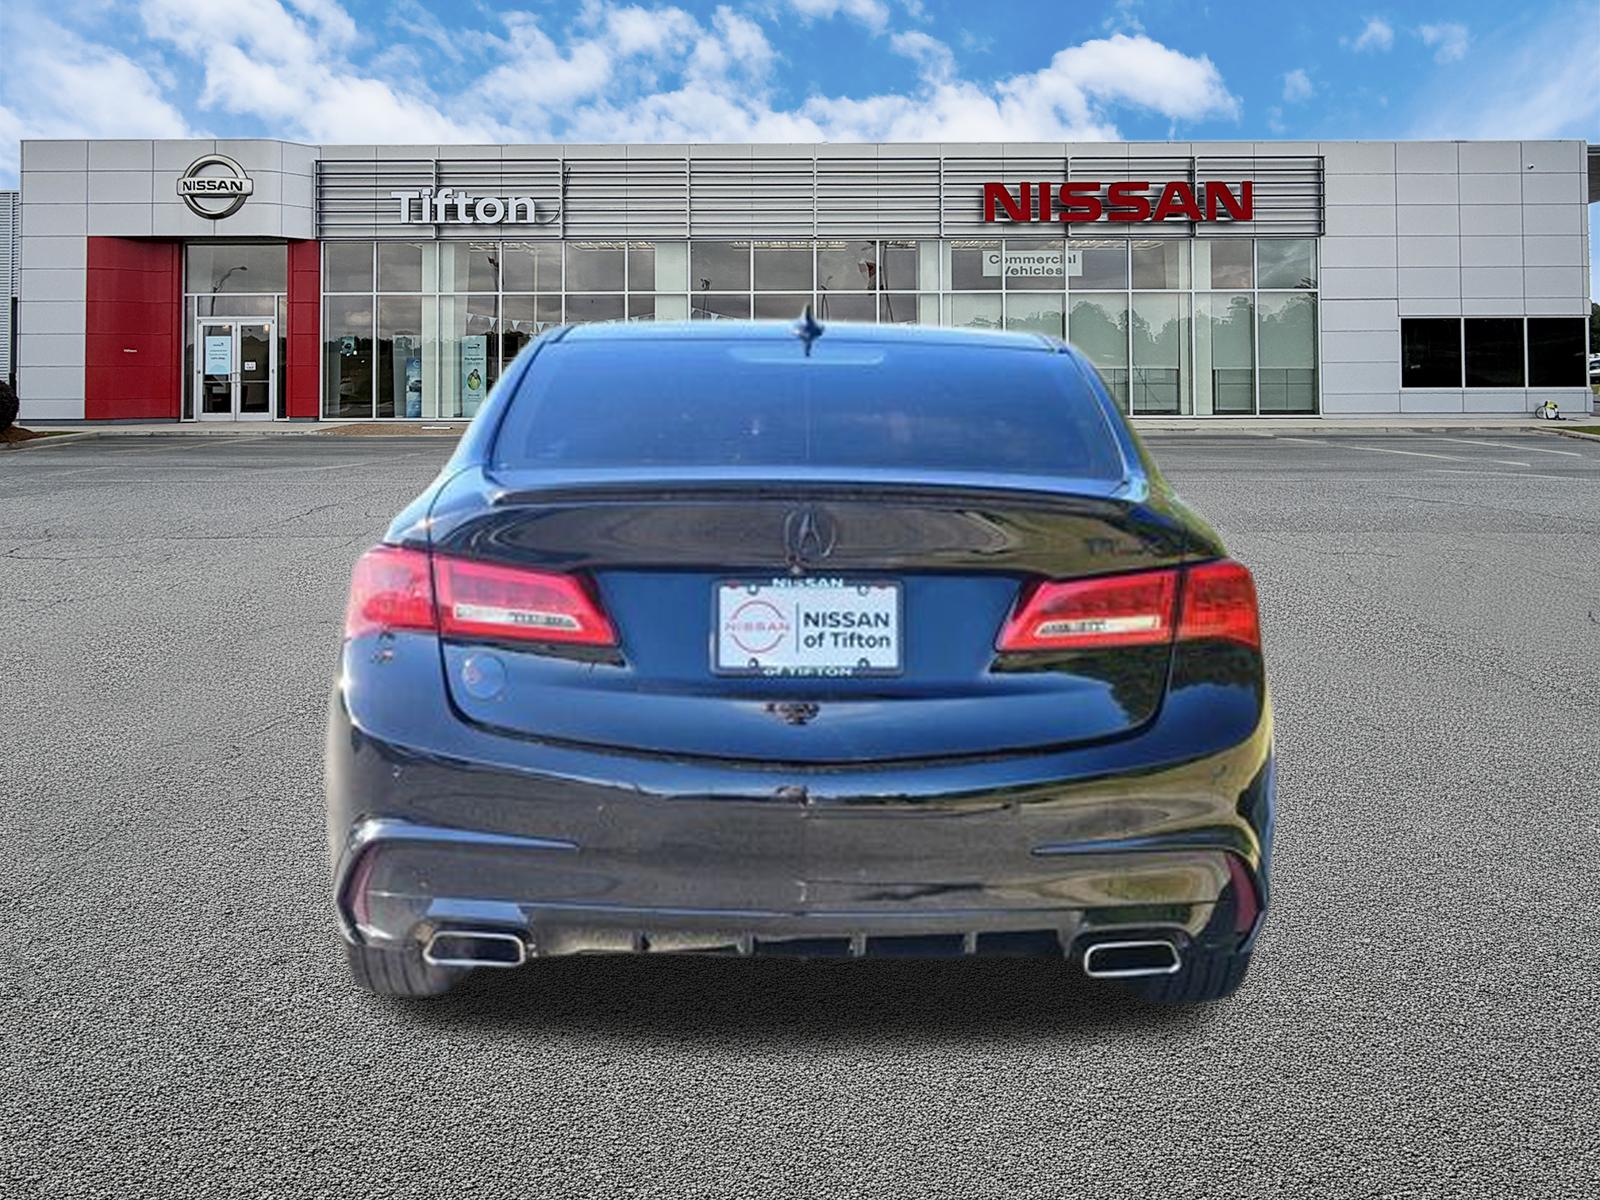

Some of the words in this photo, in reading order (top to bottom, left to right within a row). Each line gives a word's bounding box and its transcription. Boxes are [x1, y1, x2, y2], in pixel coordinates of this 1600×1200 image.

[182, 180, 243, 191] NISSAN
[391, 188, 536, 224] Tifton
[983, 181, 1254, 222] NISSAN
[772, 577, 844, 587] NISSAN
[724, 621, 790, 631] NISSAN
[804, 612, 890, 628] NISSAN
[803, 632, 826, 648] of
[831, 632, 892, 648] Tifton
